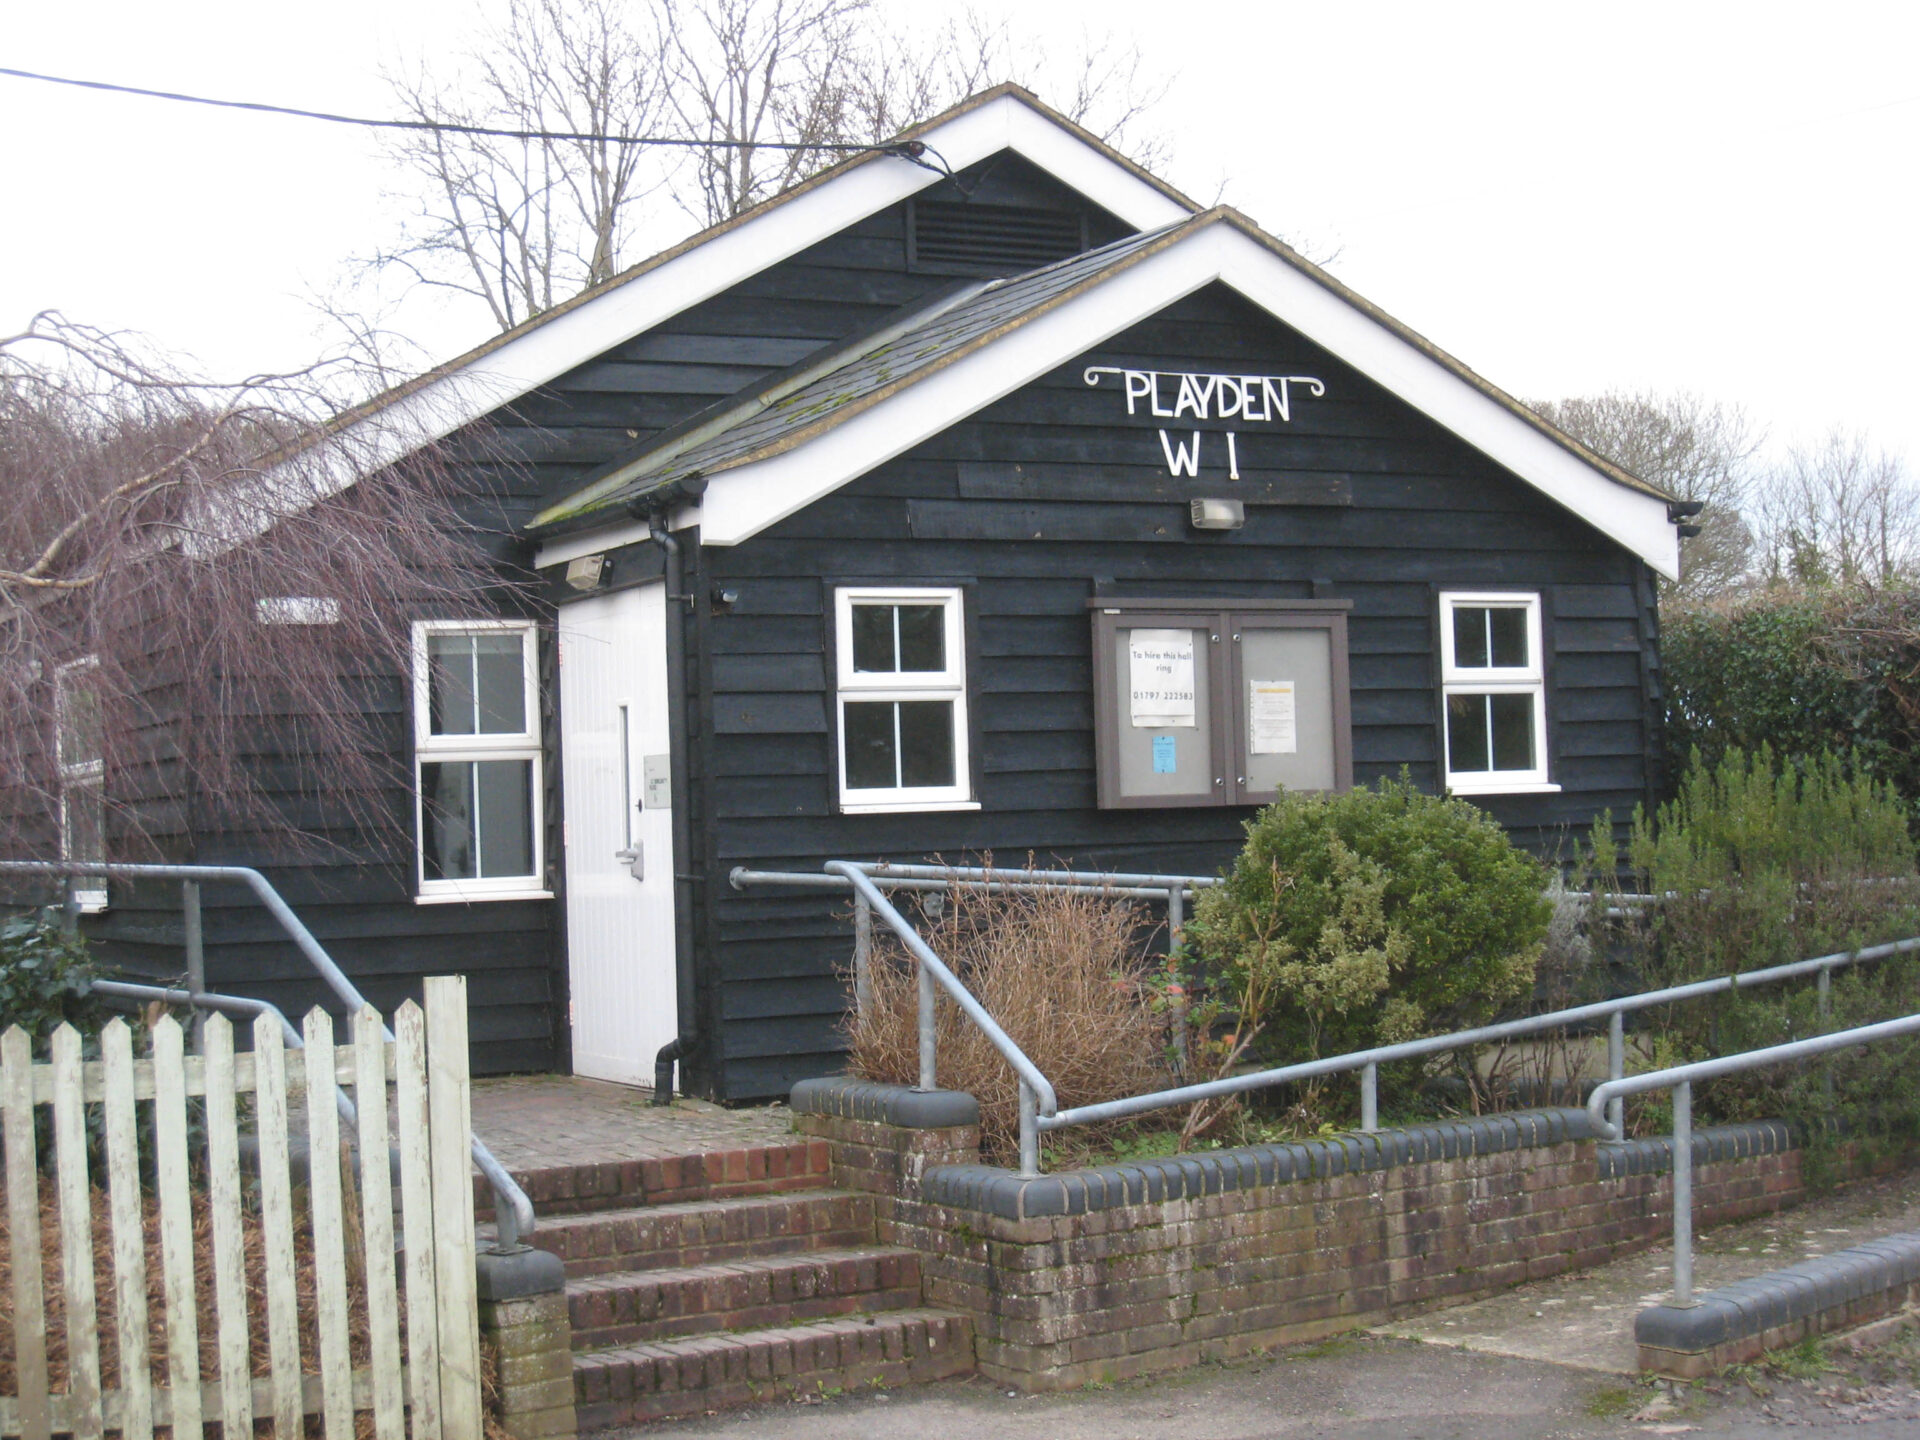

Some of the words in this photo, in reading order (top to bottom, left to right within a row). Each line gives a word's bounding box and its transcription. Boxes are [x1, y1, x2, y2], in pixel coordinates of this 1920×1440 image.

[1124, 371, 1290, 421] PLAYDEN
[1159, 429, 1200, 477] W
[1226, 432, 1240, 480] I
[1132, 650, 1143, 659] To
[1145, 650, 1161, 660] hire
[1163, 650, 1176, 660] this
[1177, 651, 1192, 661] hall
[1156, 663, 1172, 674] ring
[1133, 691, 1160, 700] 01797
